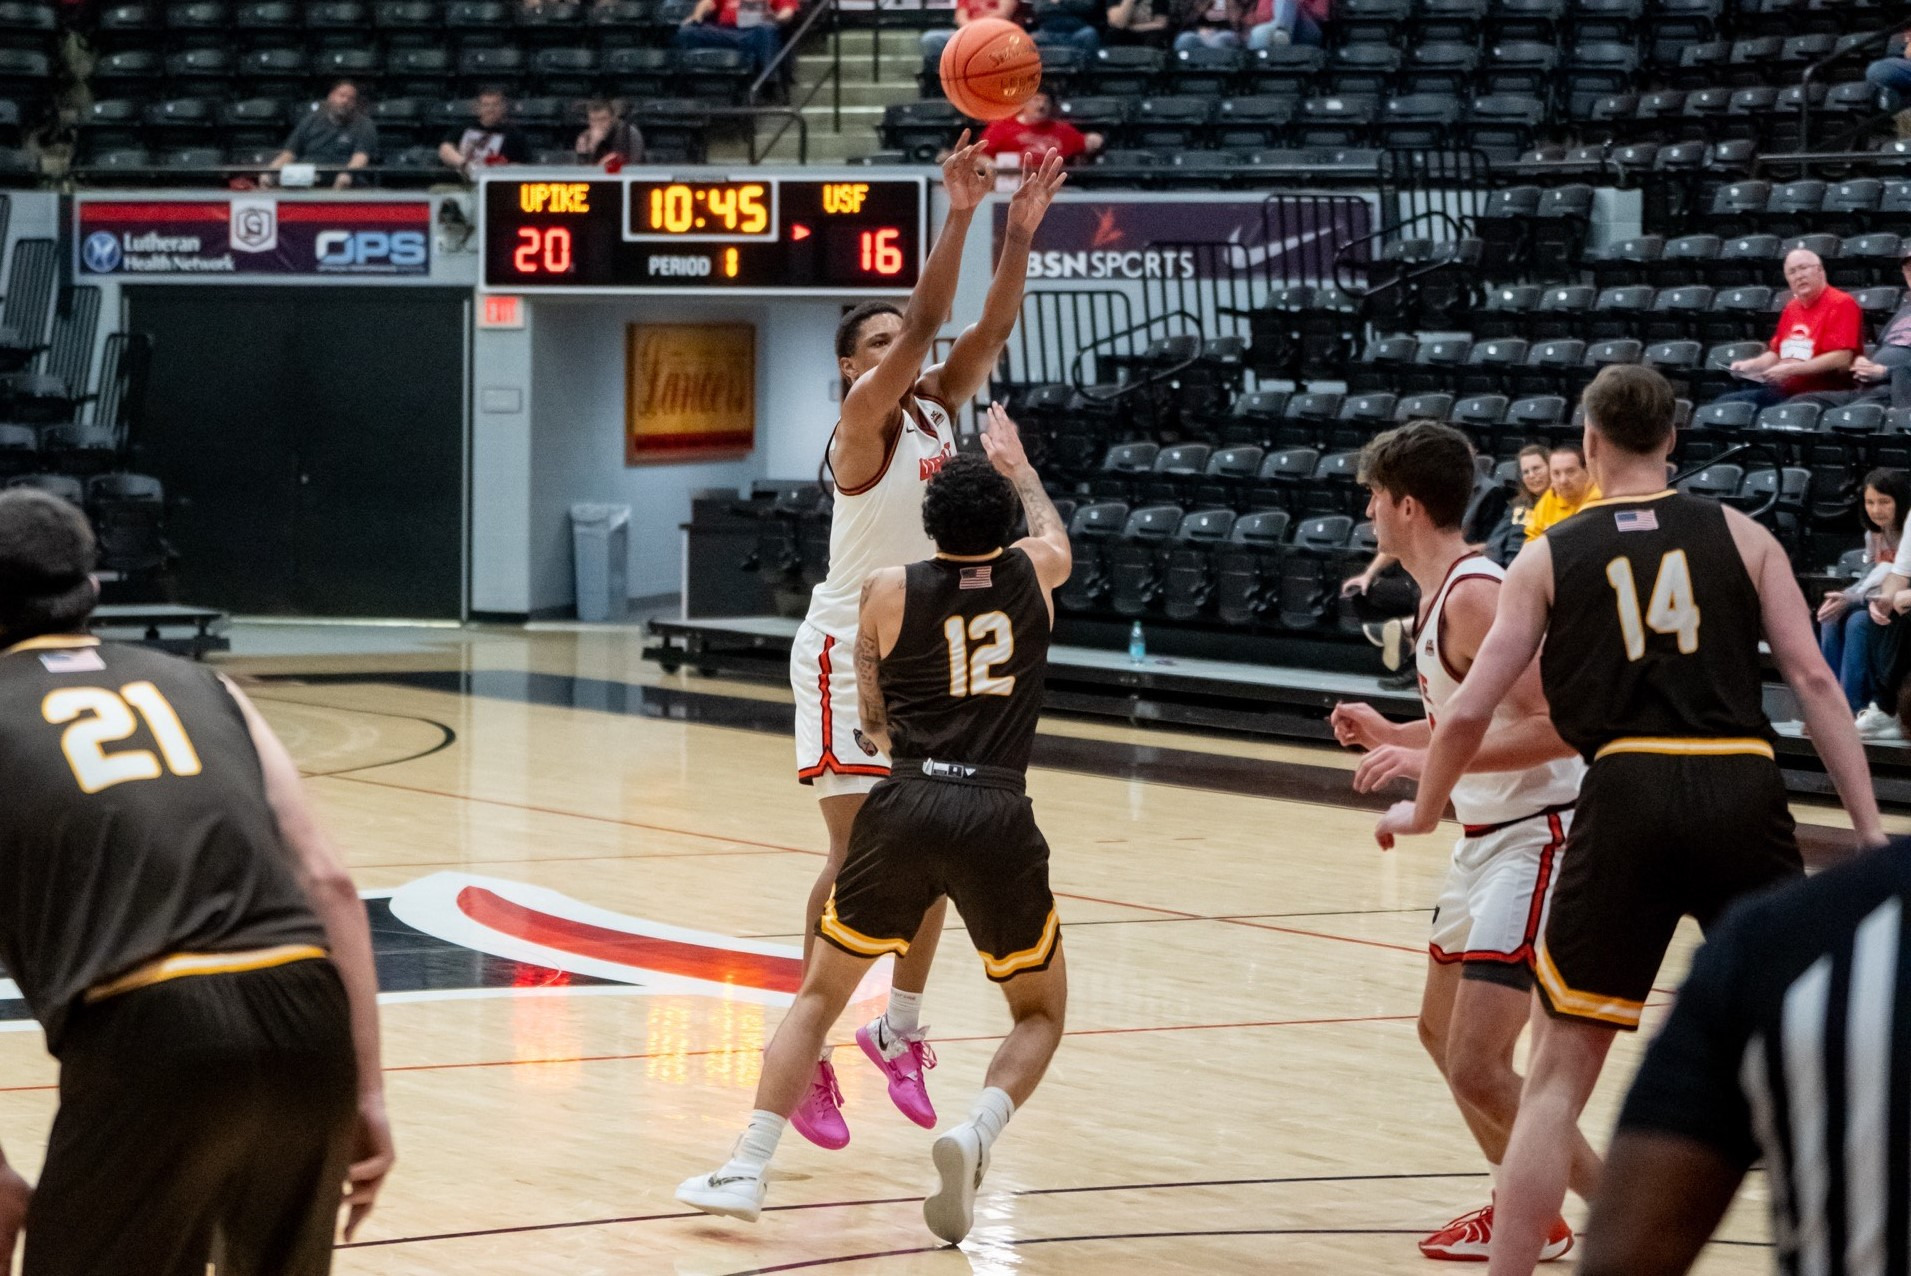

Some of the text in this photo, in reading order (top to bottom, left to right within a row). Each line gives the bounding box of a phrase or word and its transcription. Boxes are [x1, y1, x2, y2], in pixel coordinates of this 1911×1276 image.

[520, 184, 590, 212] UPIKE
[649, 185, 768, 232] 10:45
[823, 184, 869, 213] USF
[123, 231, 201, 252] Lutheran
[315, 230, 427, 266] OPS
[514, 227, 571, 272] 20
[860, 228, 903, 274] 16
[172, 253, 235, 271] Network
[648, 247, 738, 278] PERIOD 1
[1026, 252, 1195, 279] BSN SPORTS
[1606, 549, 1701, 662] 14
[944, 610, 1016, 697] 12
[41, 680, 202, 794] 21
